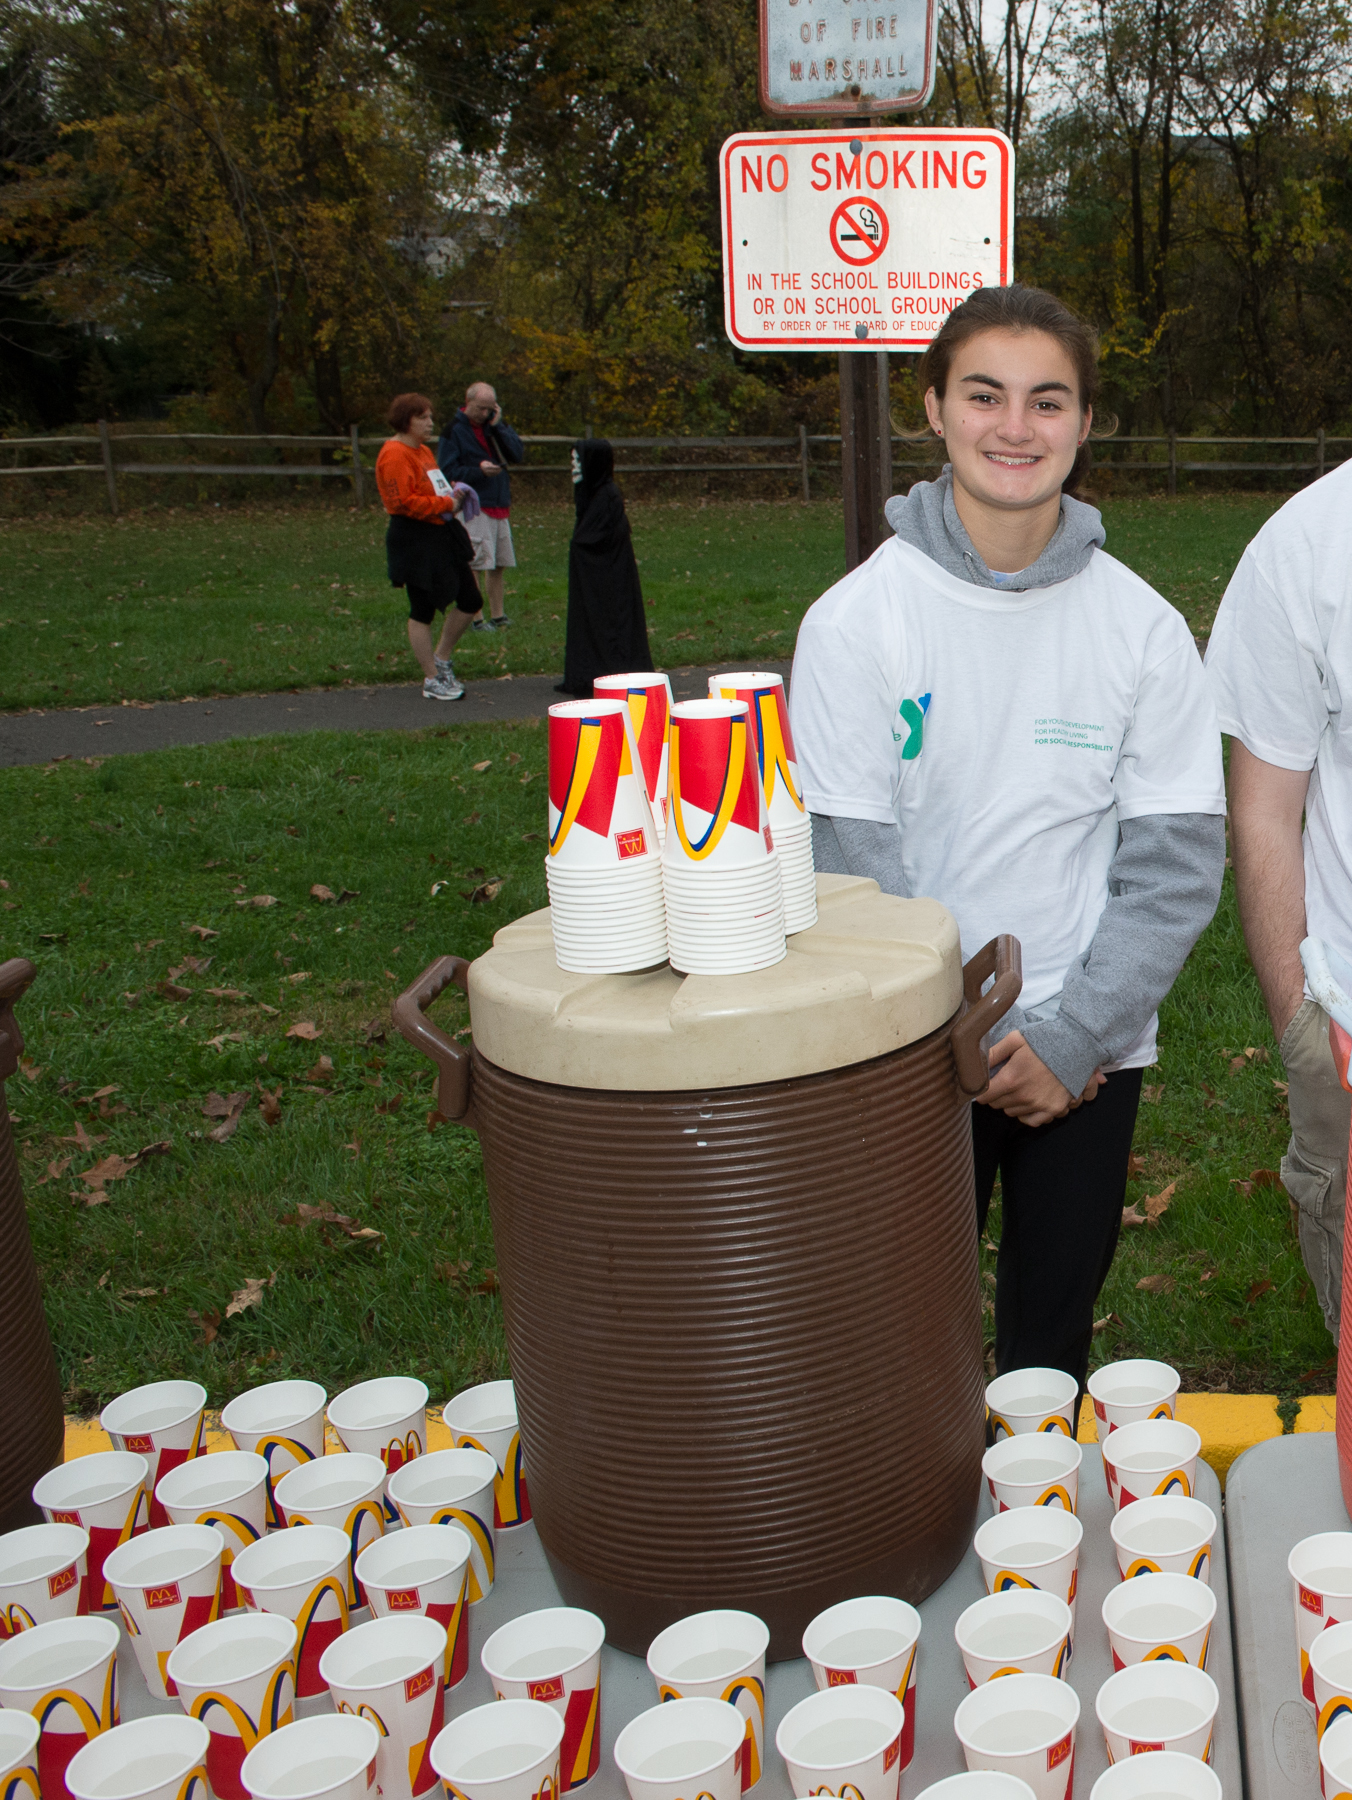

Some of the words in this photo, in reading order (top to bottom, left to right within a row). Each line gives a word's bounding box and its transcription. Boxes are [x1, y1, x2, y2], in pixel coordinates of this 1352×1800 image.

[800, 19, 828, 43] OF
[852, 14, 898, 41] FIRE
[789, 54, 908, 82] MARSHALL
[740, 153, 789, 193] NO
[810, 150, 987, 192] SMOKING
[747, 273, 762, 290] IN
[770, 272, 802, 290] THE
[811, 272, 878, 290] SCHOOL
[887, 271, 983, 290] BUILDINGS
[753, 298, 775, 315] OR
[784, 297, 806, 314] ON
[815, 297, 882, 315] SCHOOL
[891, 296, 966, 315] GROUND
[763, 320, 775, 331] BY
[780, 320, 811, 331] ORDER
[816, 320, 828, 331] OF
[833, 320, 851, 331] THE
[892, 320, 906, 331] OF
[910, 320, 946, 332] EDUCA
[1065, 721, 1105, 732] DEVELOPMENT
